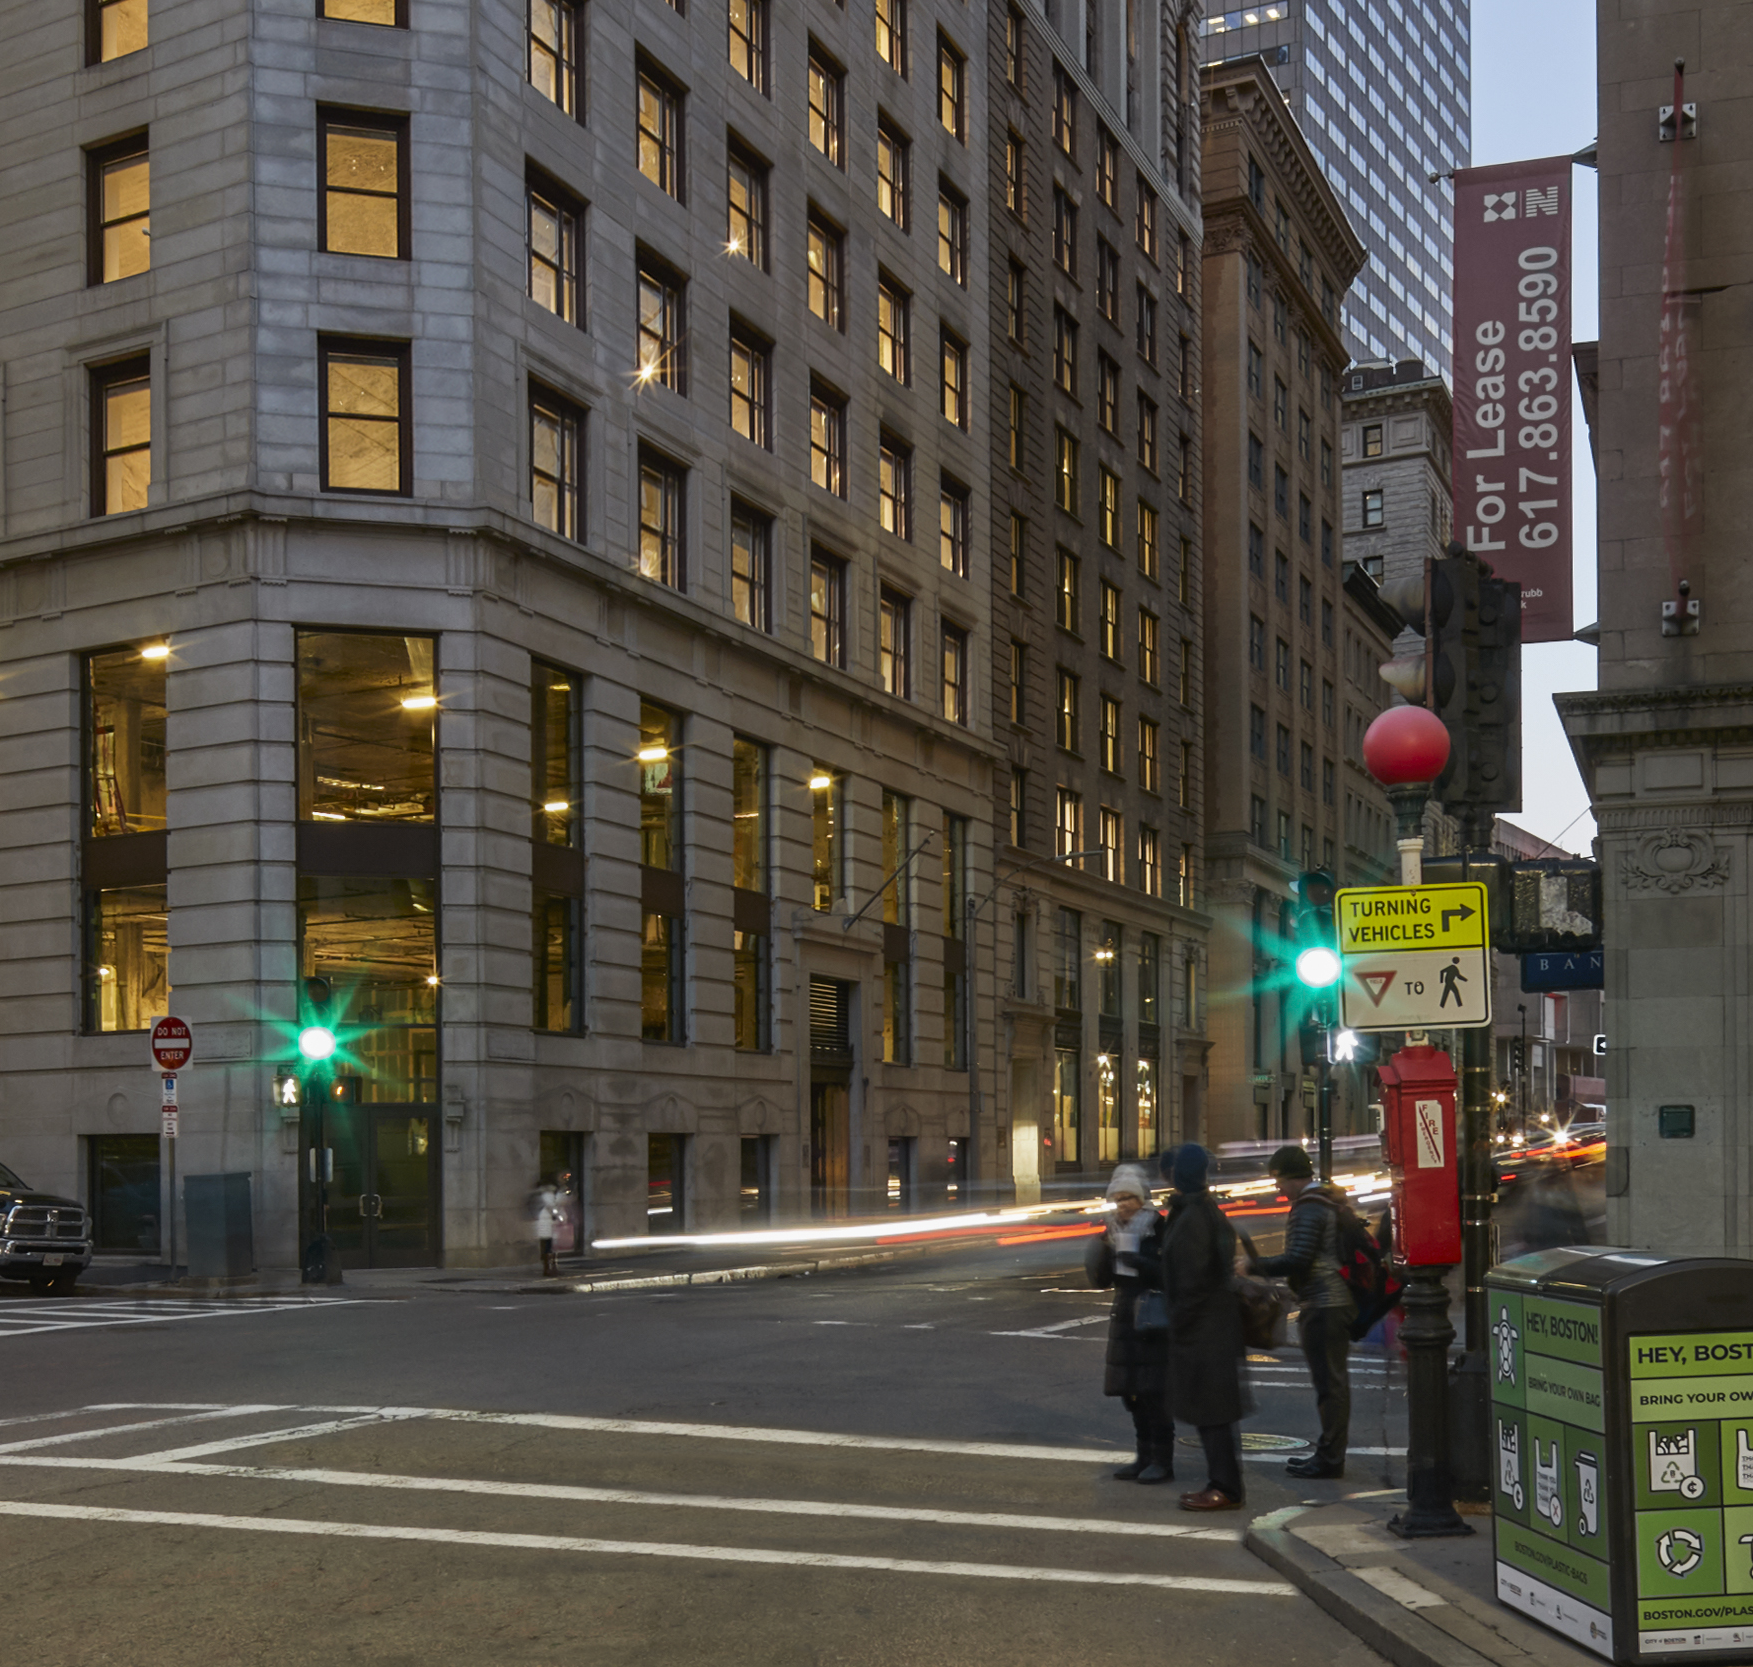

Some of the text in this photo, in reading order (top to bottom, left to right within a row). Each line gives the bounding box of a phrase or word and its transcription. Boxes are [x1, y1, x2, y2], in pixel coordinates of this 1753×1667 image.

[1518, 246, 1559, 549] 617.863.8590
[1466, 320, 1507, 552] For Lease
[1521, 588, 1544, 599] rubb
[1350, 897, 1432, 918] TURNING
[1349, 922, 1436, 943] VEHICLES
[1539, 955, 1602, 971] BAN
[1404, 980, 1425, 996] TO
[157, 1027, 187, 1036] DO NOT
[160, 1051, 185, 1060] ENTER
[1422, 1104, 1439, 1136] FIRE
[1526, 1311, 1599, 1346] HEY, BOSTON!
[1637, 1343, 1753, 1366] HEY, BOST
[1528, 1376, 1601, 1408] BRING YOUR OWN BAG
[1639, 1394, 1684, 1406] BRING
[1686, 1392, 1726, 1404] YOUR
